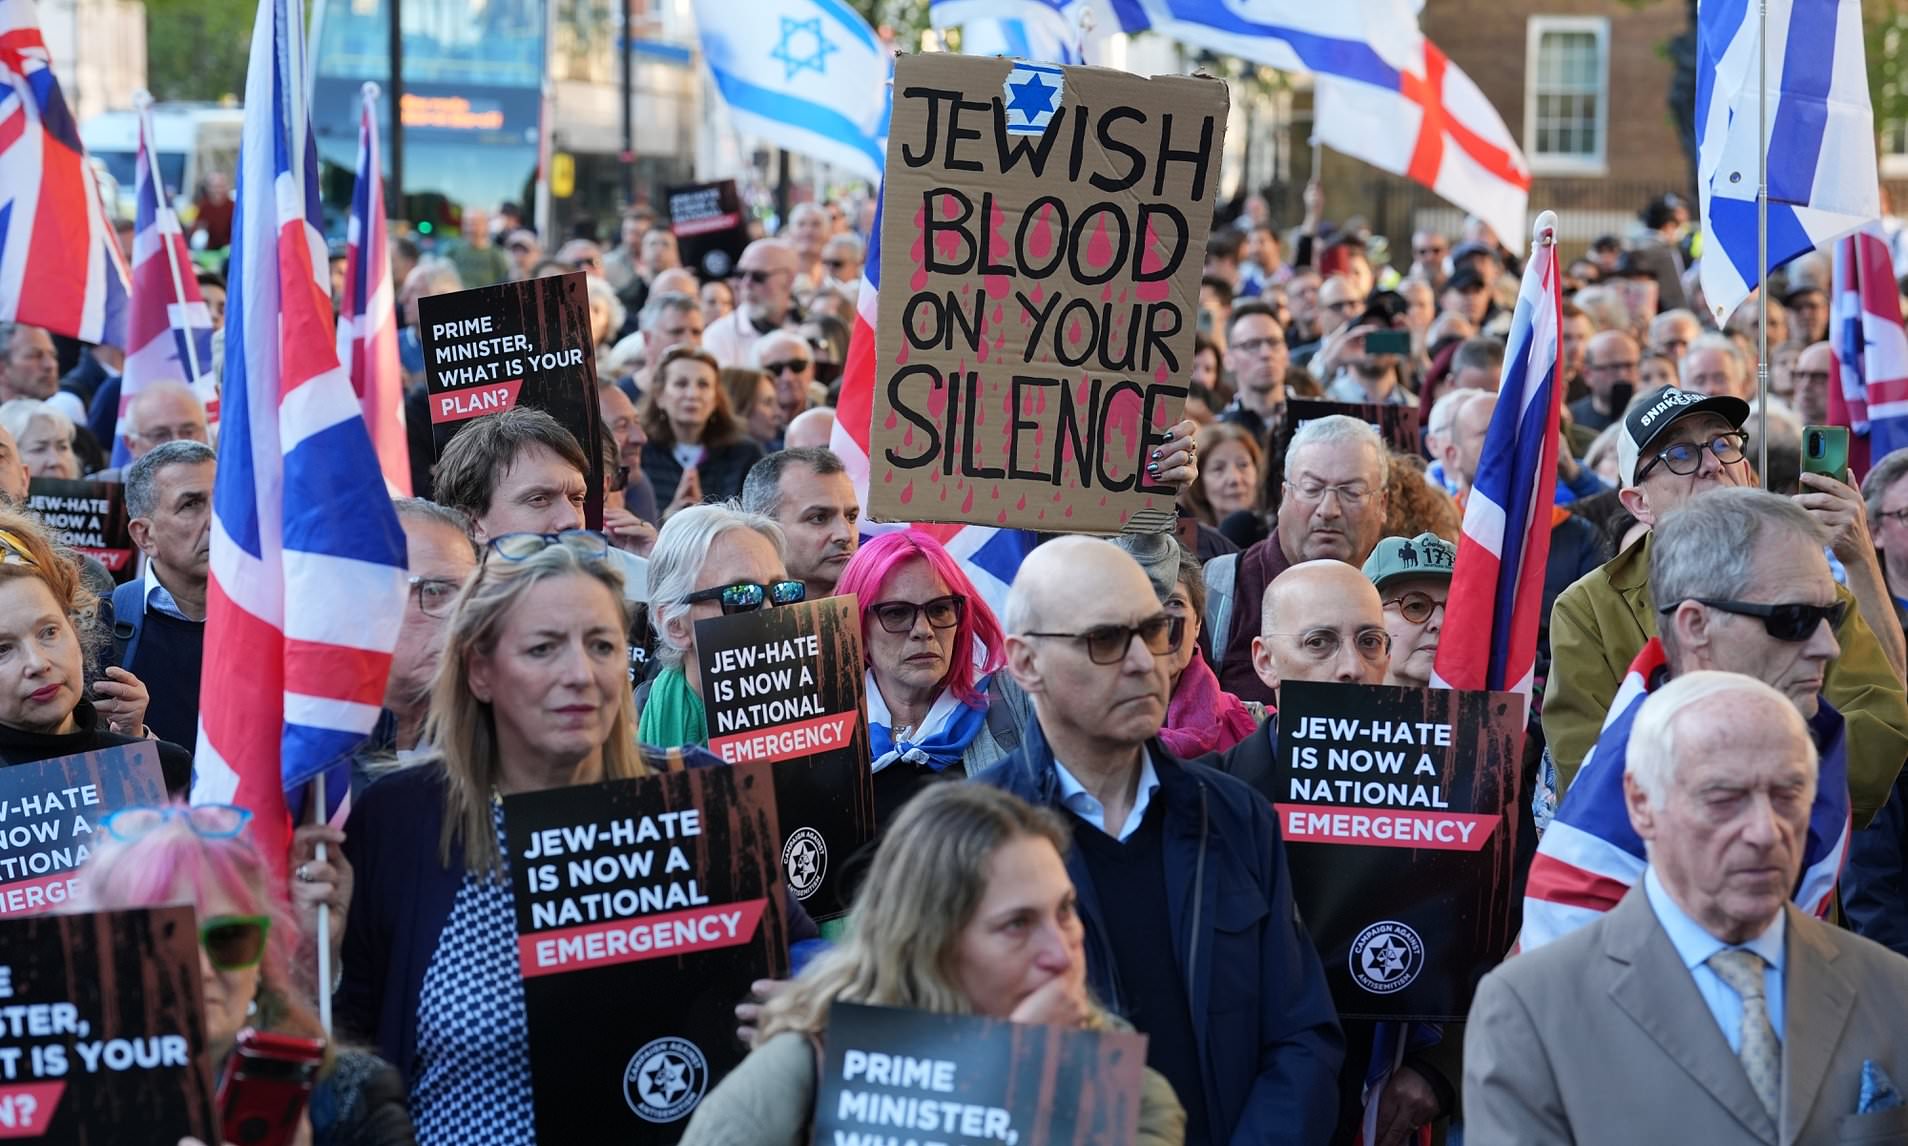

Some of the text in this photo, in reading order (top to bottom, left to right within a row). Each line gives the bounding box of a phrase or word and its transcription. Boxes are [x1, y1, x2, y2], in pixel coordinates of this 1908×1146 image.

[902, 87, 1214, 201] JEWISH
[923, 187, 1189, 285] BLOOD
[432, 316, 493, 341] PRIME
[902, 291, 1182, 372] ON YOUR
[435, 334, 533, 364] MINISTER,
[438, 348, 583, 387] WHAT IS YOUR
[441, 388, 509, 416] PLAN?
[885, 364, 1189, 496] SILENCE
[27, 495, 110, 514] JEW-HATE
[87, 516, 101, 530] A
[710, 634, 820, 674] JEW-HATE
[713, 665, 814, 703] IS NOW A
[717, 693, 825, 733] NATIONAL
[1291, 716, 1453, 747] JEW-HATE
[721, 720, 844, 764] EMERGENCY
[1291, 746, 1437, 776] IS NOW A
[1289, 778, 1449, 809] NATIONAL
[72, 815, 93, 837] A
[523, 809, 702, 860] JEW-HATE
[1288, 811, 1477, 844] EMERGENCY
[0, 844, 91, 882] TIONA
[527, 846, 690, 894] IS NOW A
[531, 879, 709, 930] NATIONAL
[535, 911, 742, 968] EMERGENCY
[1354, 925, 1421, 955] CAMPAIGN AGAINST
[1357, 973, 1412, 990] ANTISEMITISM
[31, 1044, 69, 1078] IS
[75, 1034, 189, 1074] YOUR
[843, 1049, 957, 1093] PRIME
[837, 1088, 1019, 1146] MINISTER,
